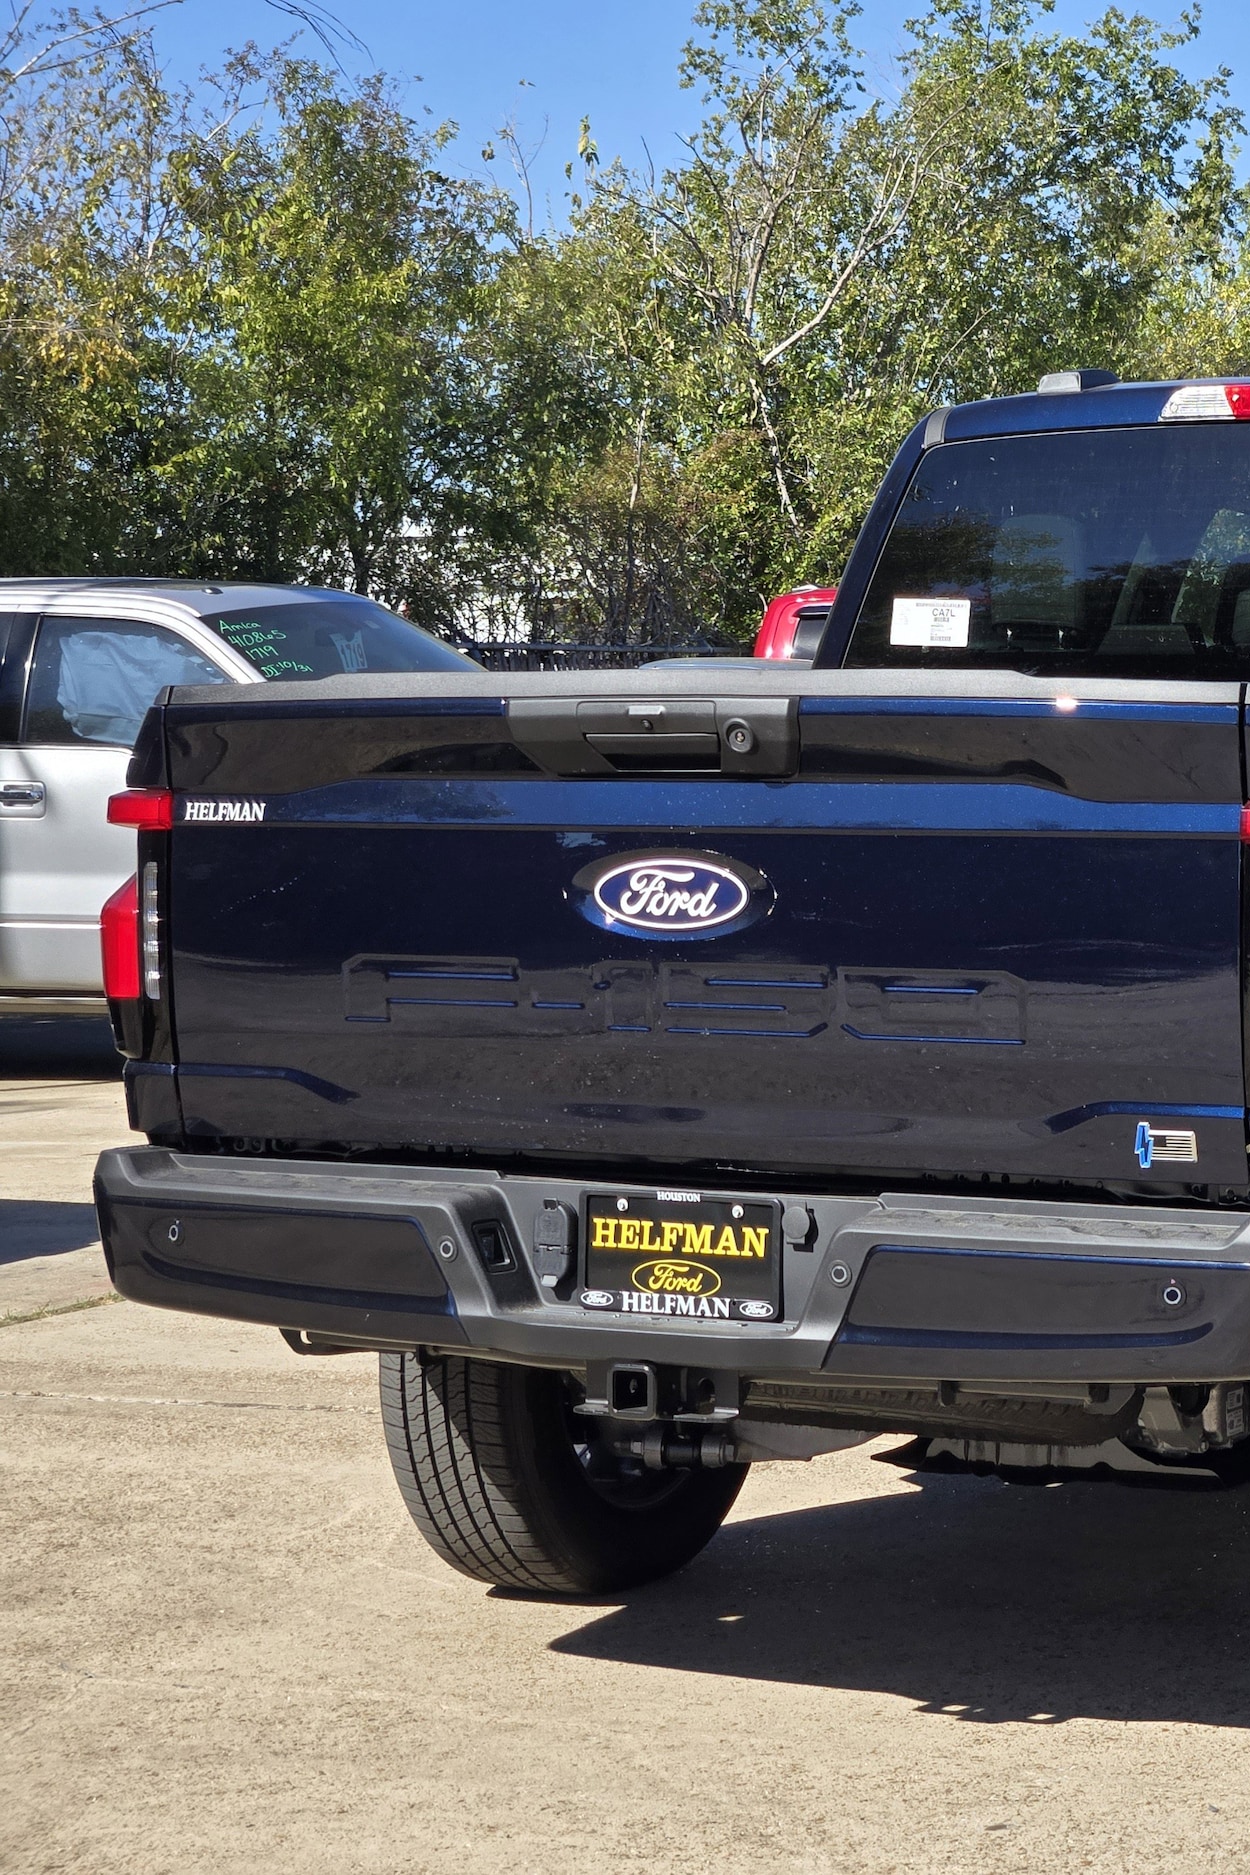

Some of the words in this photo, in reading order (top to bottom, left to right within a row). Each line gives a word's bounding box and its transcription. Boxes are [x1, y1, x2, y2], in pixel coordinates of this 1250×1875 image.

[931, 607, 956, 617] CA7L
[227, 629, 287, 648] 410865
[245, 645, 279, 661] 1719
[184, 802, 266, 821] HELFMAN
[620, 868, 720, 918] Ford
[656, 1191, 701, 1202] HOUSTON
[592, 1217, 770, 1258] HELFMAN
[648, 1262, 703, 1293] Ford
[621, 1291, 731, 1318] HELFMAN
